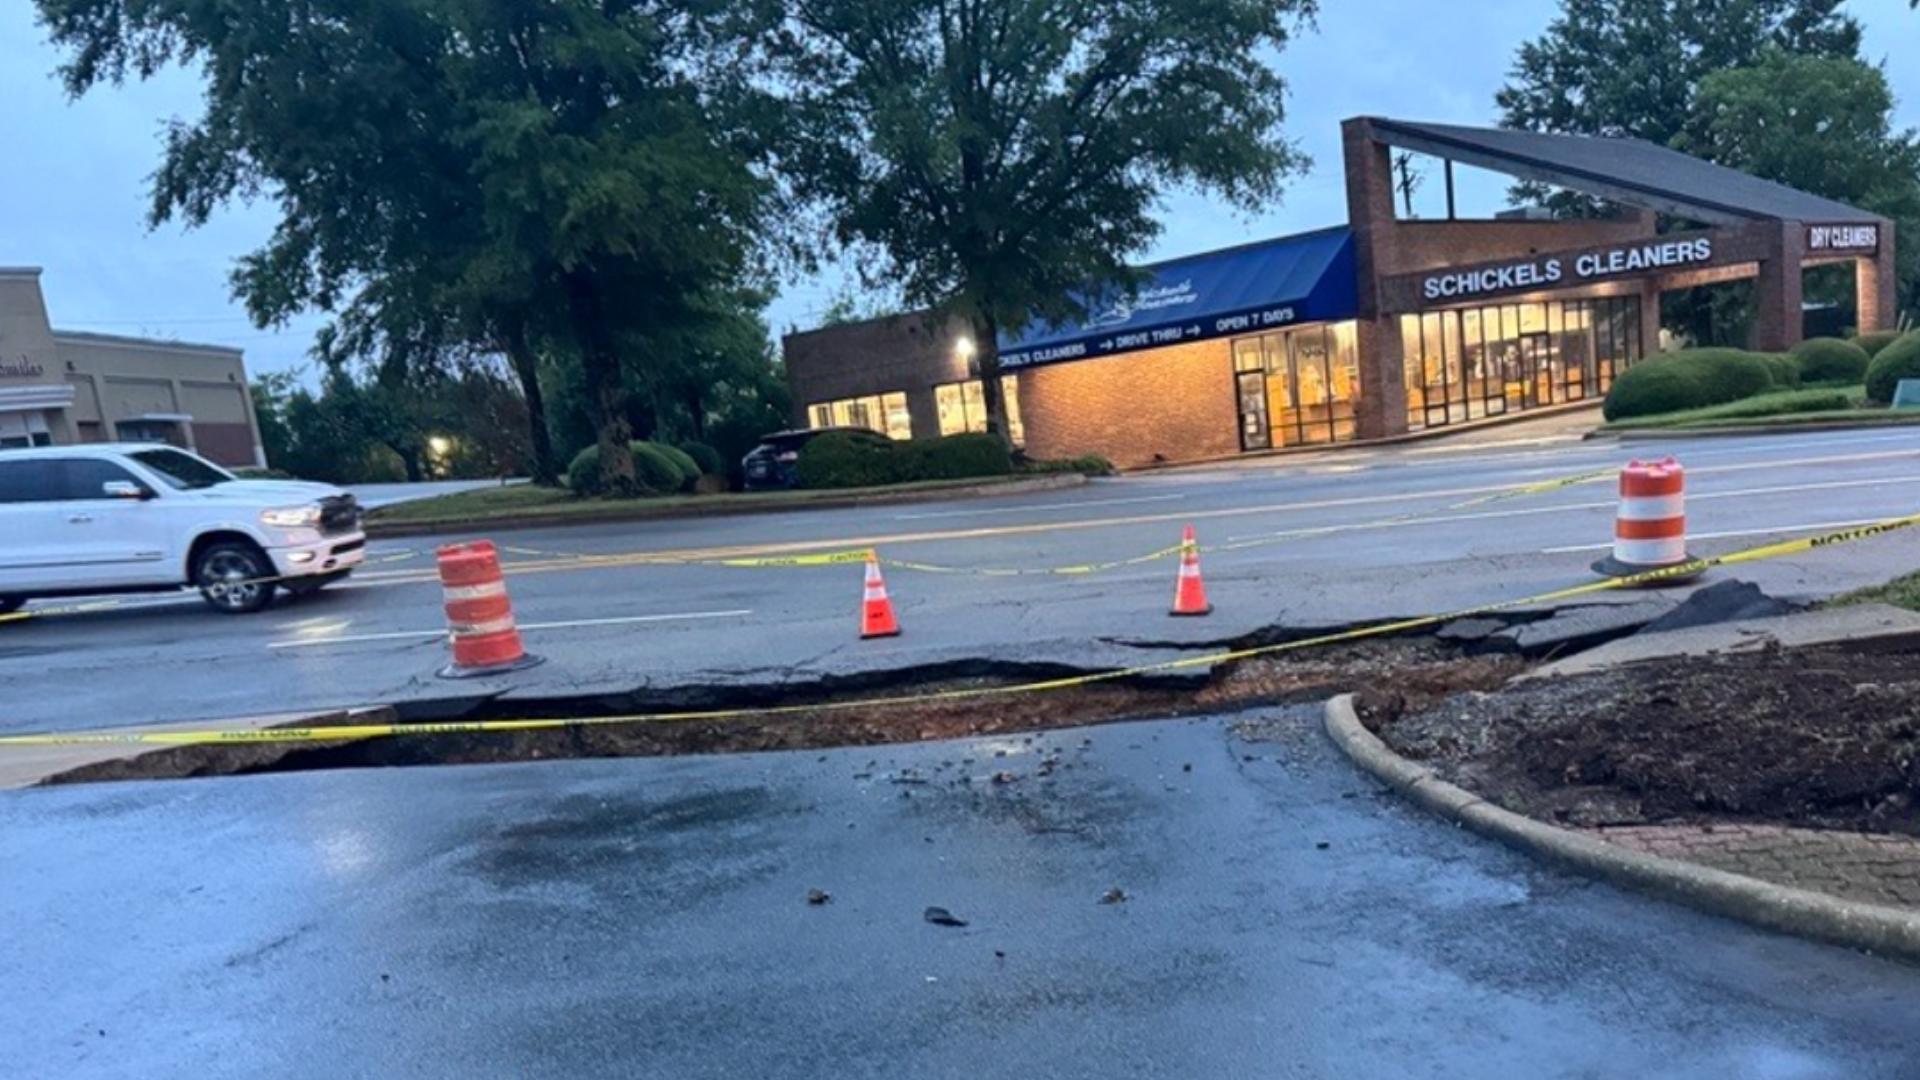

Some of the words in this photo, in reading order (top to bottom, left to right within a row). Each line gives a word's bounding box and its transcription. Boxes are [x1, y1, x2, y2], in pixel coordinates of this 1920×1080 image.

[1811, 226, 1830, 248] DRY
[1831, 225, 1876, 247] CLEANERS
[1424, 259, 1562, 298] SCHICKELS
[1576, 238, 1711, 276] CLEANERS
[1032, 343, 1087, 362] CLEANERS
[1116, 331, 1149, 348] DRIVE
[1152, 327, 1182, 343] THRU
[1216, 317, 1248, 332] OPEN
[1252, 313, 1259, 326] 7
